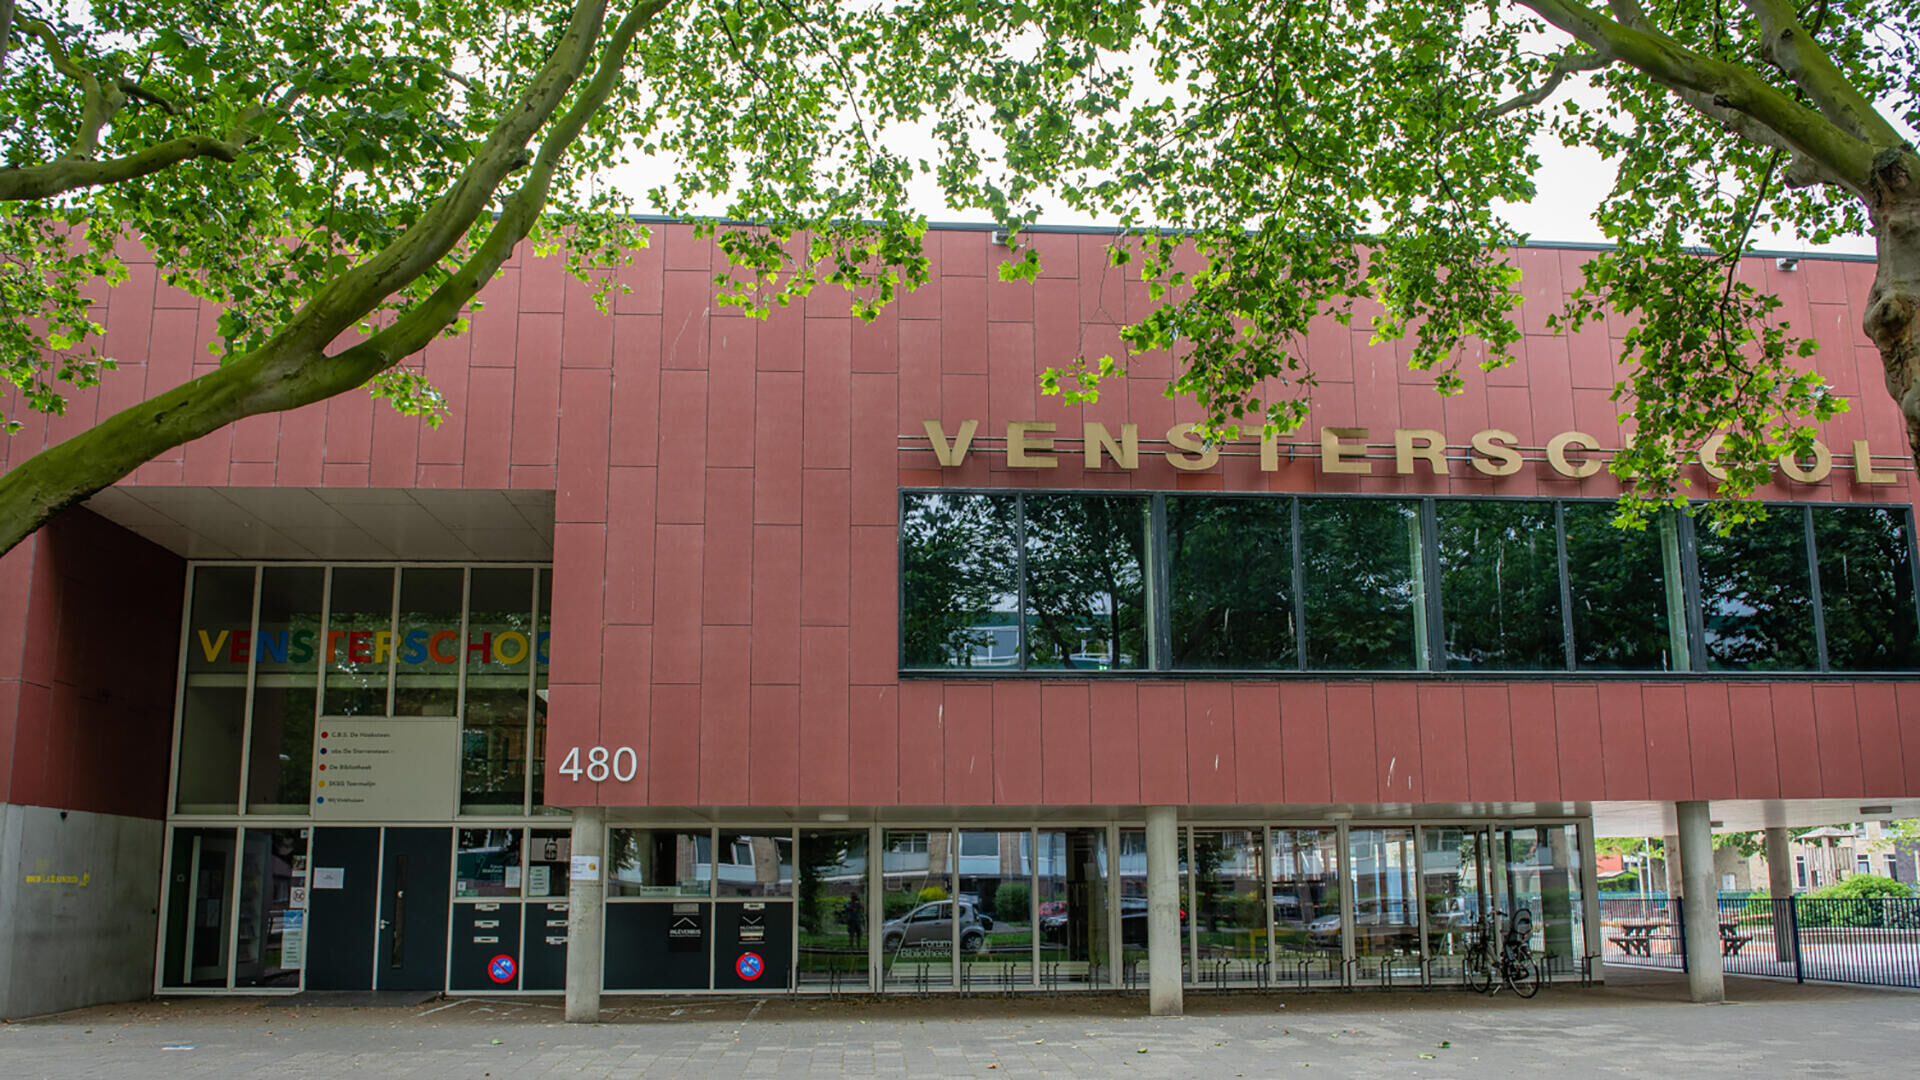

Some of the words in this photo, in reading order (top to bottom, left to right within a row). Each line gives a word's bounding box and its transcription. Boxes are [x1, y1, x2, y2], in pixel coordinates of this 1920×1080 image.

[559, 746, 637, 782] 480
[920, 937, 952, 948] Forum
[900, 948, 952, 958] Bibliotheek
